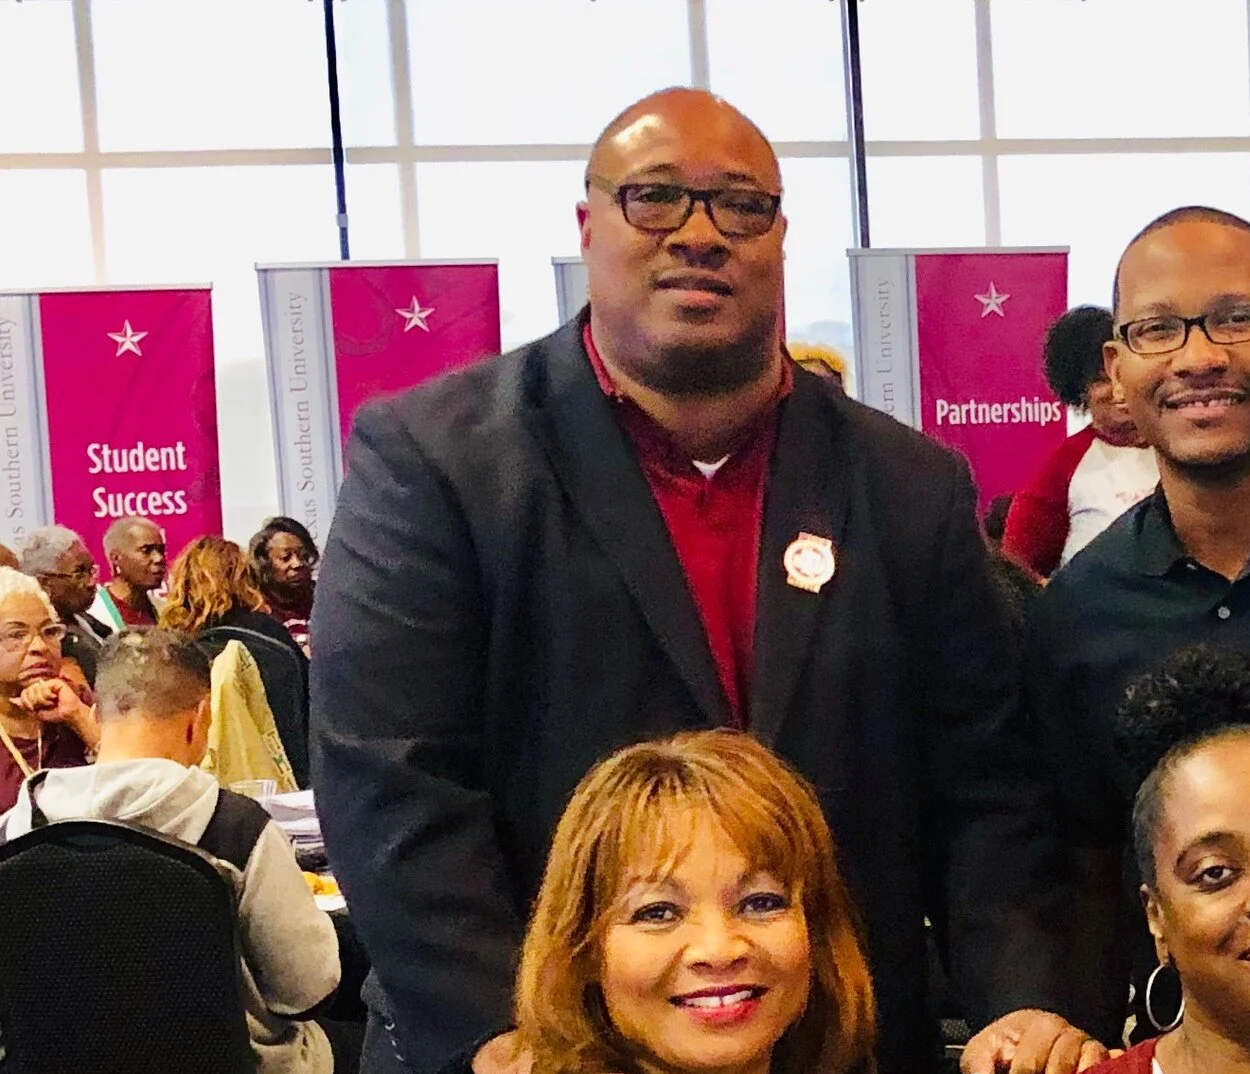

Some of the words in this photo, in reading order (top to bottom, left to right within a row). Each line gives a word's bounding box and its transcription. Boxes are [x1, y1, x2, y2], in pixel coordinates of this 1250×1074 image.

[284, 291, 308, 393] University
[936, 395, 1062, 426] Partnerships
[86, 441, 187, 474] Student
[293, 400, 315, 492] Southern
[1, 425, 25, 525] Southern
[92, 486, 188, 518] Success
[303, 499, 319, 547] exas
